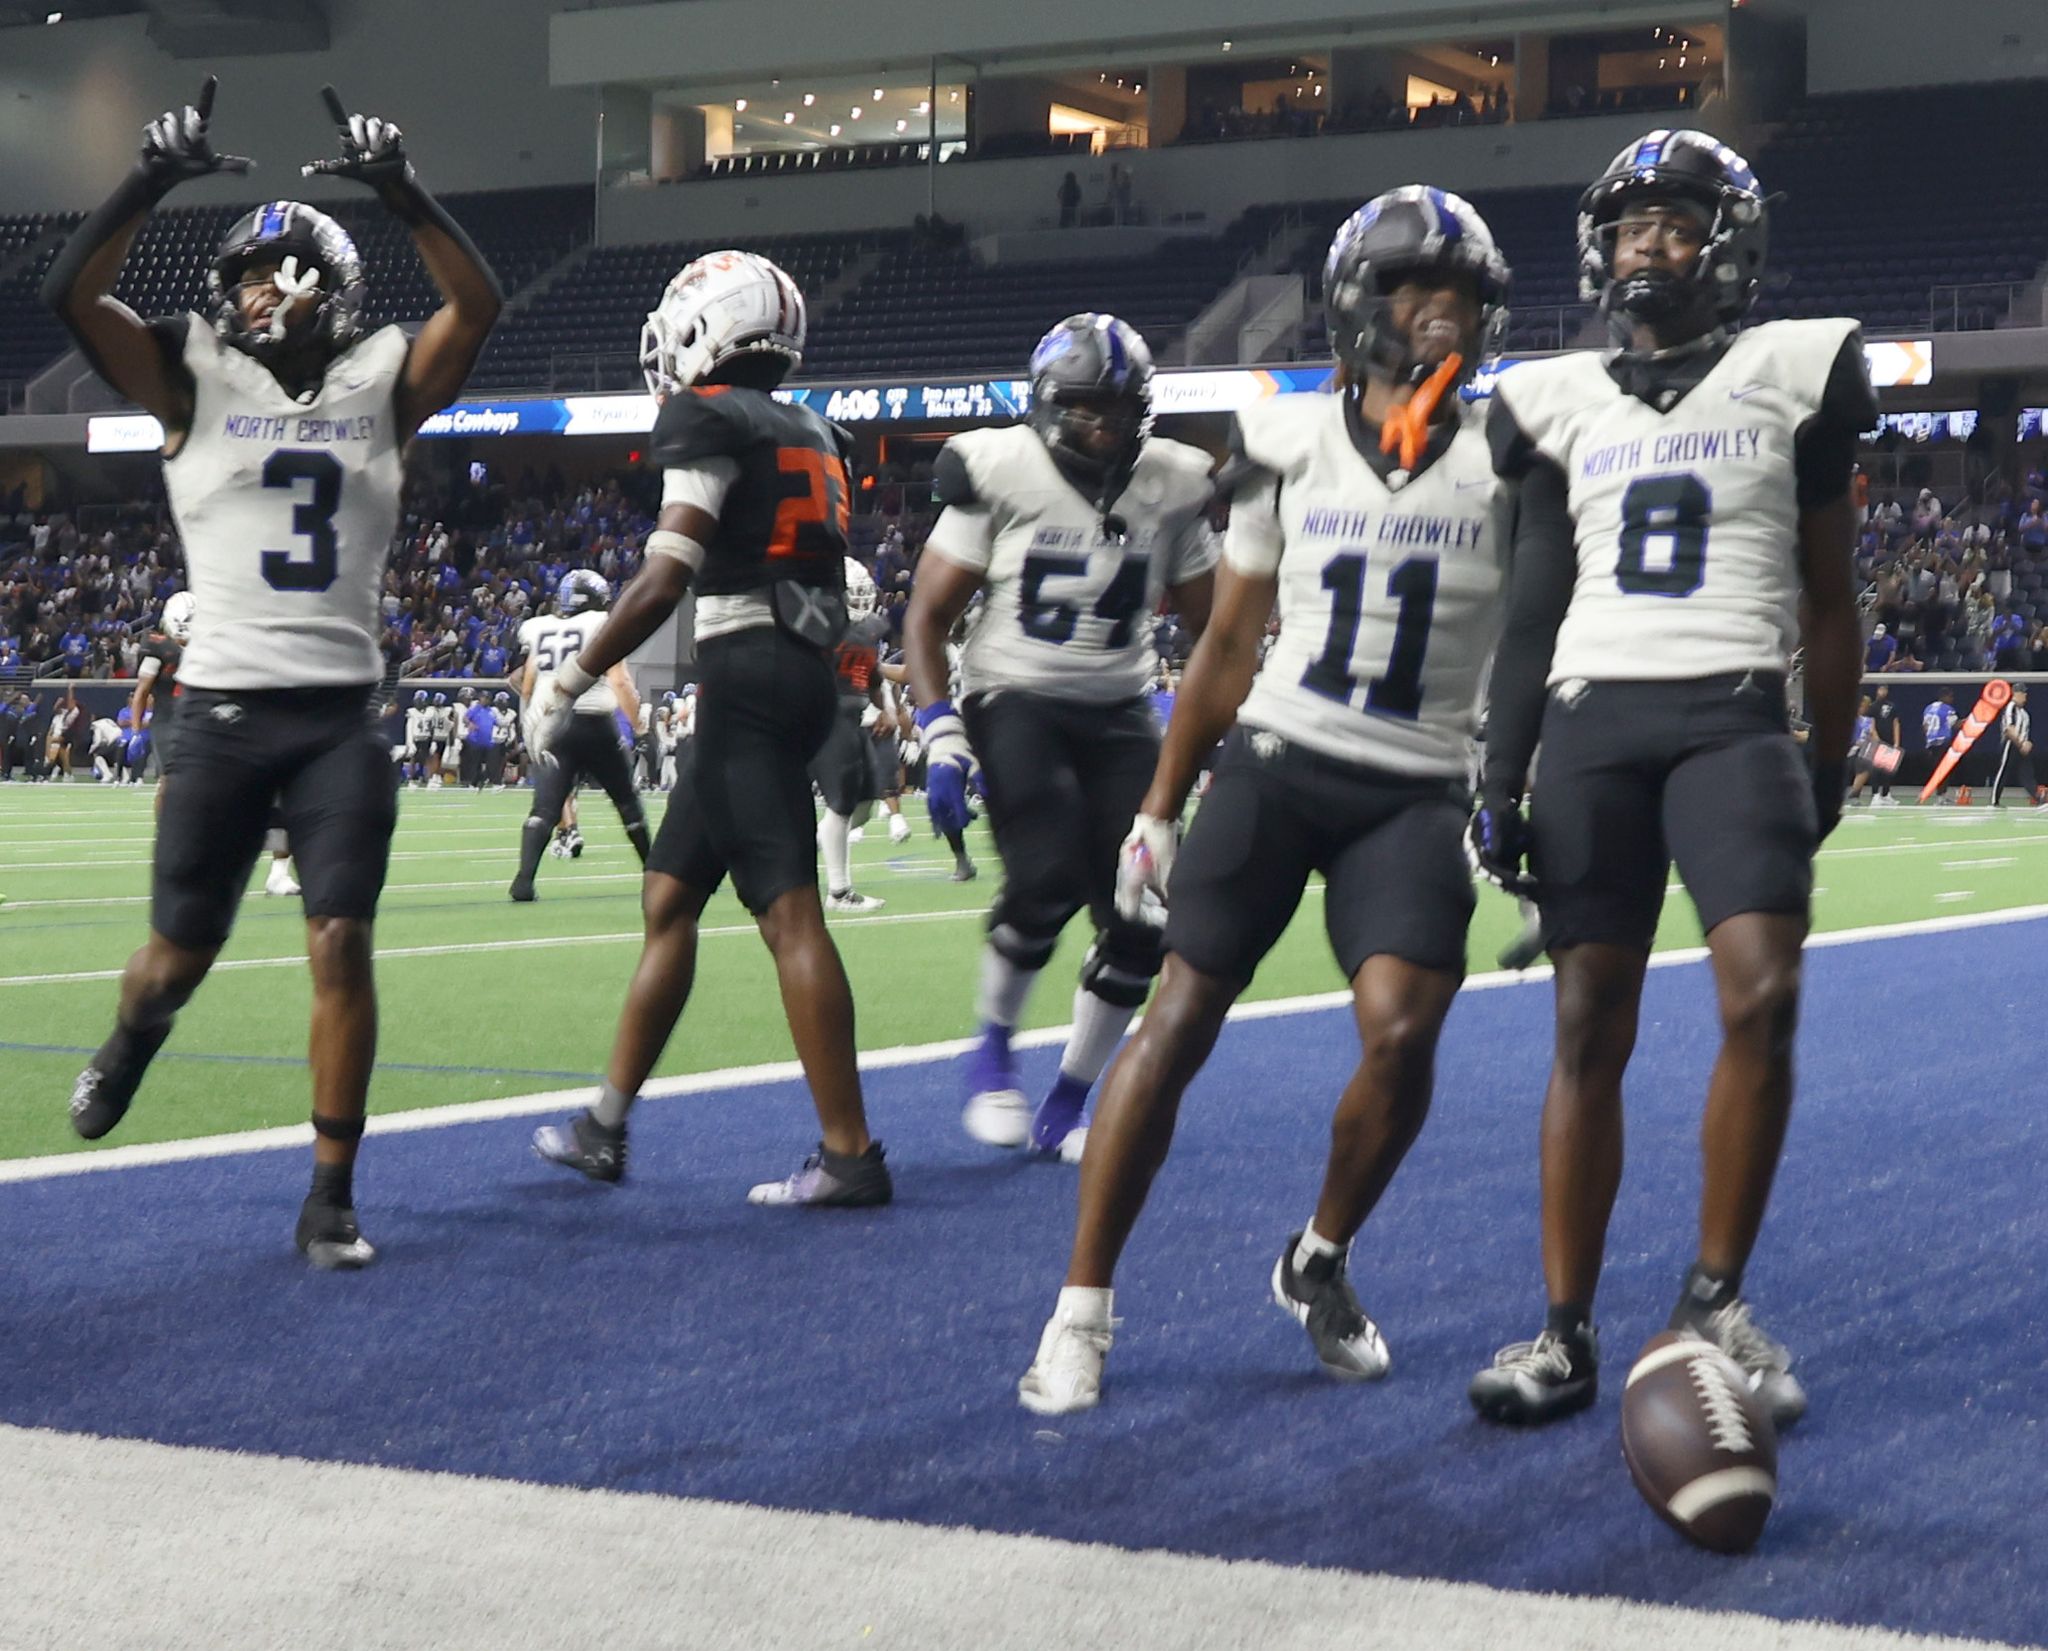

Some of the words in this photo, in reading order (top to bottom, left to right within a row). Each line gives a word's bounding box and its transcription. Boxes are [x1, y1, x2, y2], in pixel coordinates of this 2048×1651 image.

[452, 409, 520, 435] Cowboys
[825, 389, 881, 421] 4:06
[223, 414, 288, 441] NORTH
[296, 415, 375, 443] CROWLEY
[1580, 438, 1643, 481] NORTH
[1653, 427, 1761, 465] CROWLEY
[260, 447, 344, 593] 3
[1300, 507, 1368, 541] NORTH
[1376, 512, 1484, 551] CROWLEY
[1614, 468, 1712, 599] 8
[536, 630, 584, 672] 52
[1298, 545, 1440, 721] 11
